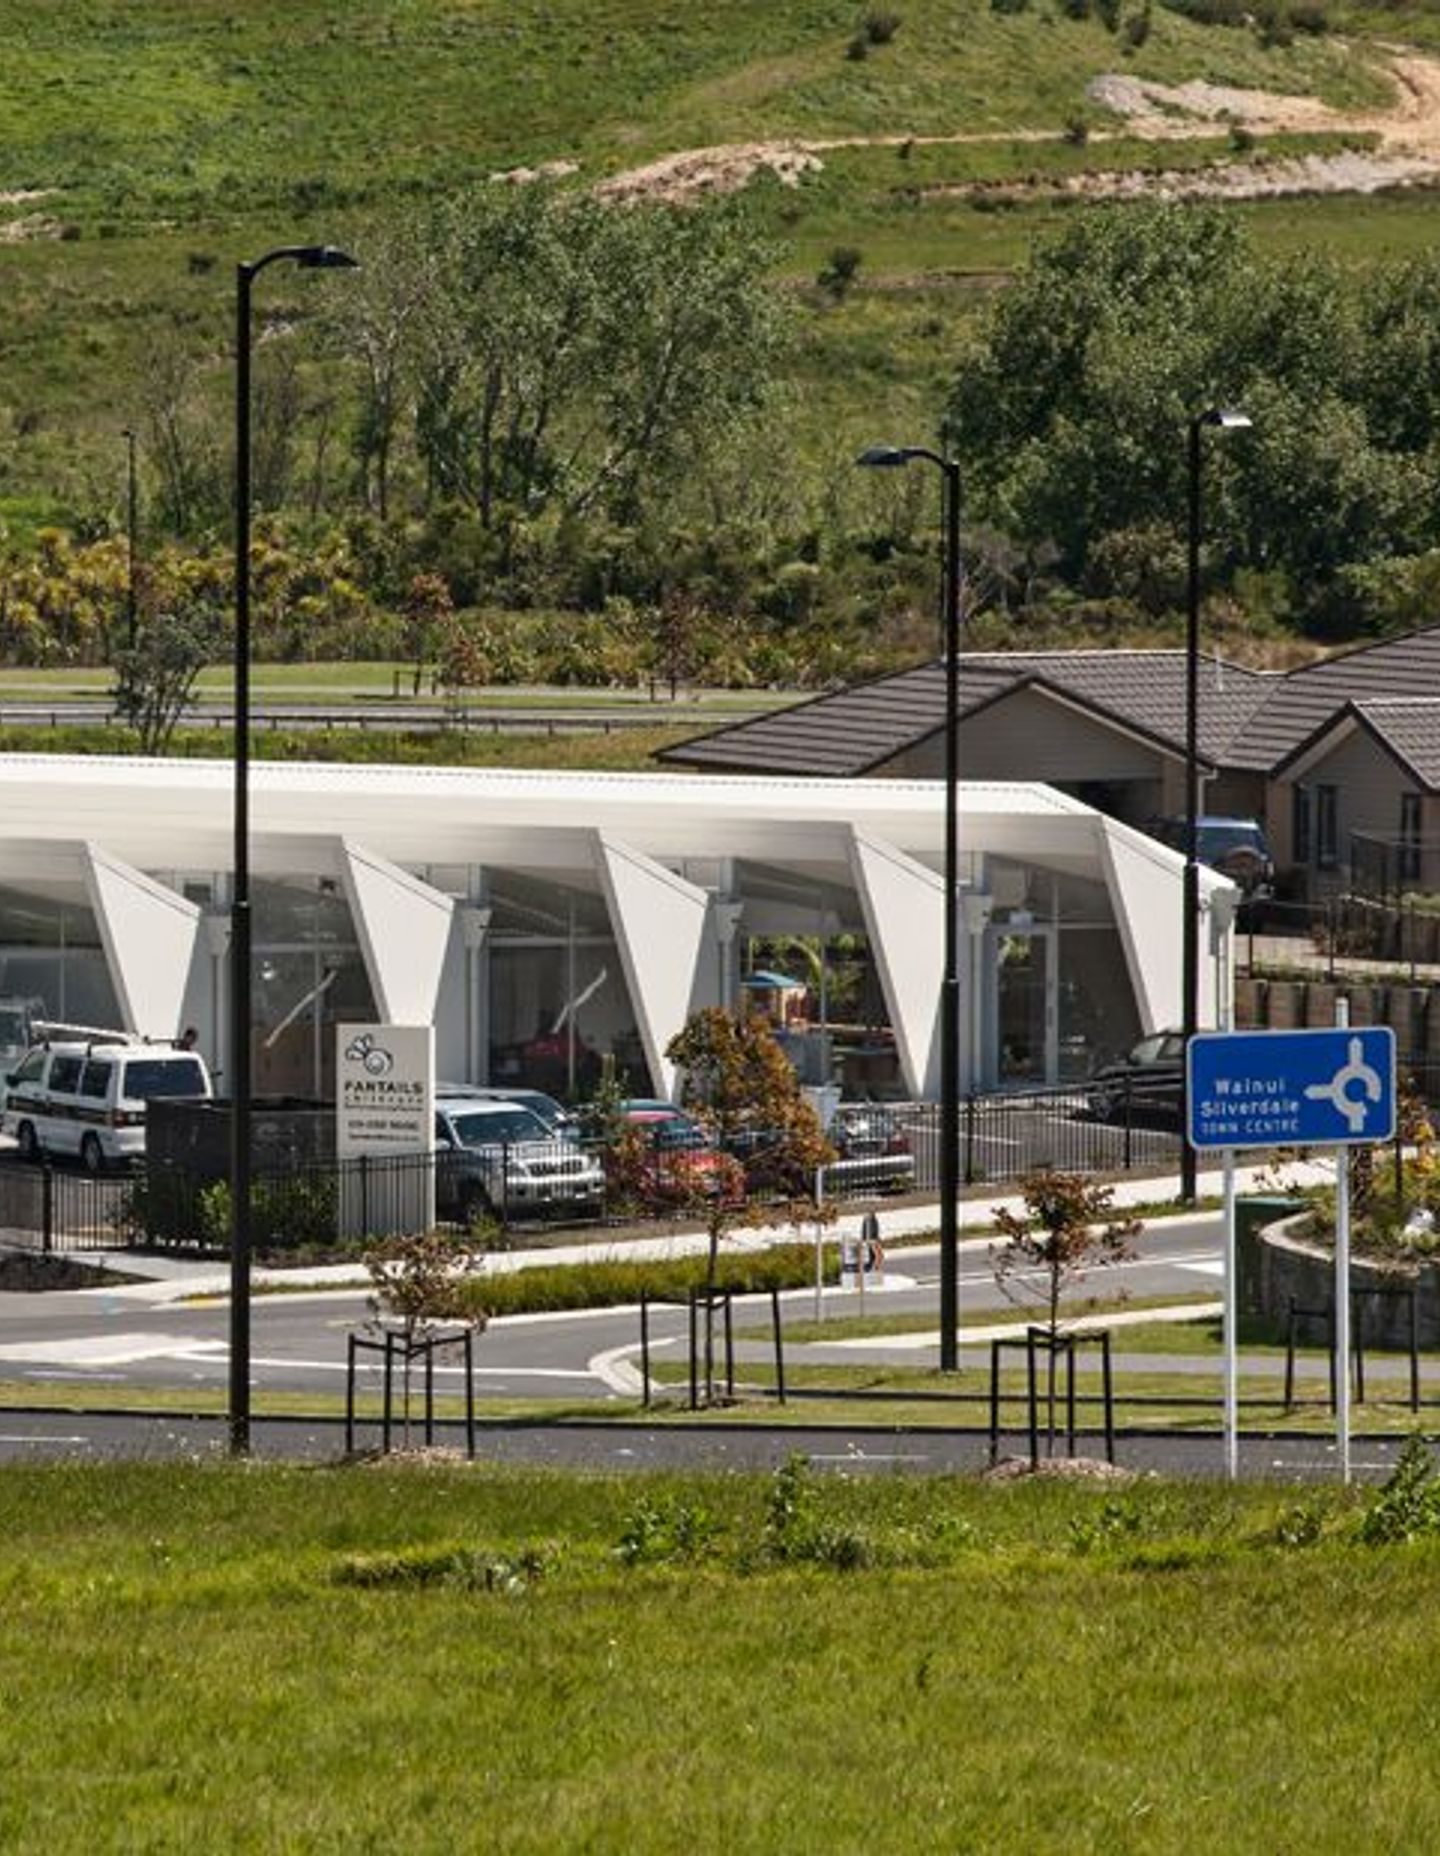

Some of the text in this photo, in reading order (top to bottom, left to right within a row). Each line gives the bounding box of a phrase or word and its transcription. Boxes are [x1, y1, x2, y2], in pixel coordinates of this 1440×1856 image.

[345, 1081, 423, 1094] FANTAILS
[1215, 1078, 1285, 1094] Wainui
[1201, 1098, 1299, 1117] Silverdale
[1245, 1119, 1299, 1133] CENTRE
